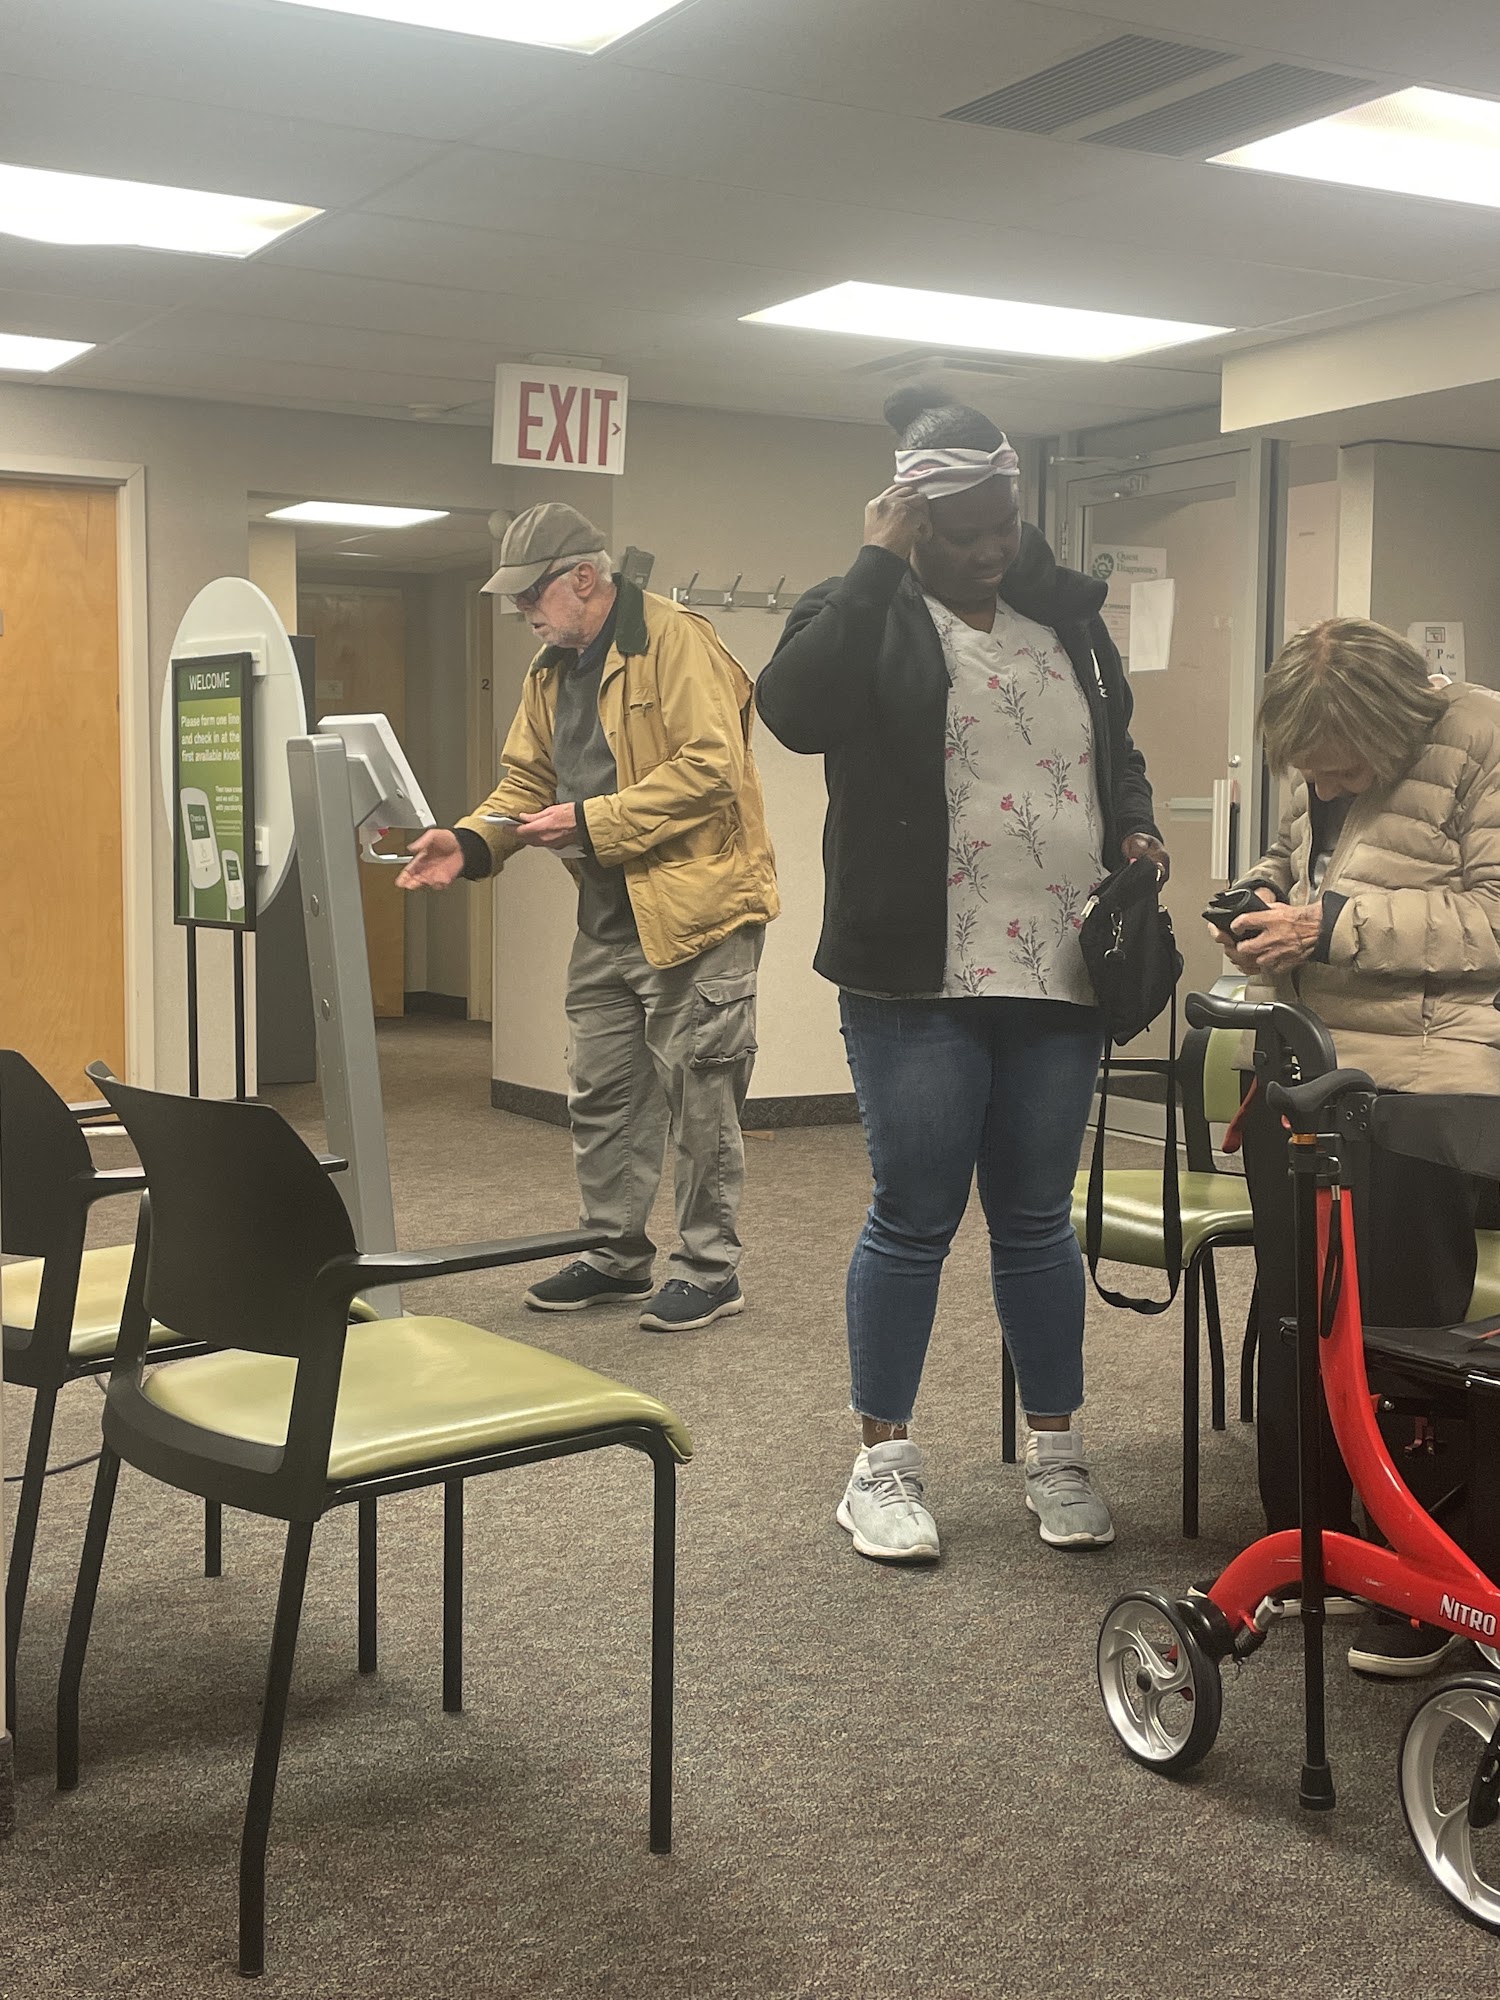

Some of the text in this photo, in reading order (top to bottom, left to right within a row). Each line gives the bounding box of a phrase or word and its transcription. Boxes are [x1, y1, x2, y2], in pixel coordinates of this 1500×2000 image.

[518, 381, 618, 466] EXIT
[1116, 550, 1139, 563] Quest
[1116, 563, 1158, 575] Diagnostics
[189, 671, 231, 691] WELCOME
[481, 678, 490, 690] 2
[181, 712, 240, 727] Please form one line
[181, 730, 240, 745] and check in at the
[181, 747, 241, 762] first available kiosk
[1440, 1594, 1497, 1636] NITRO
